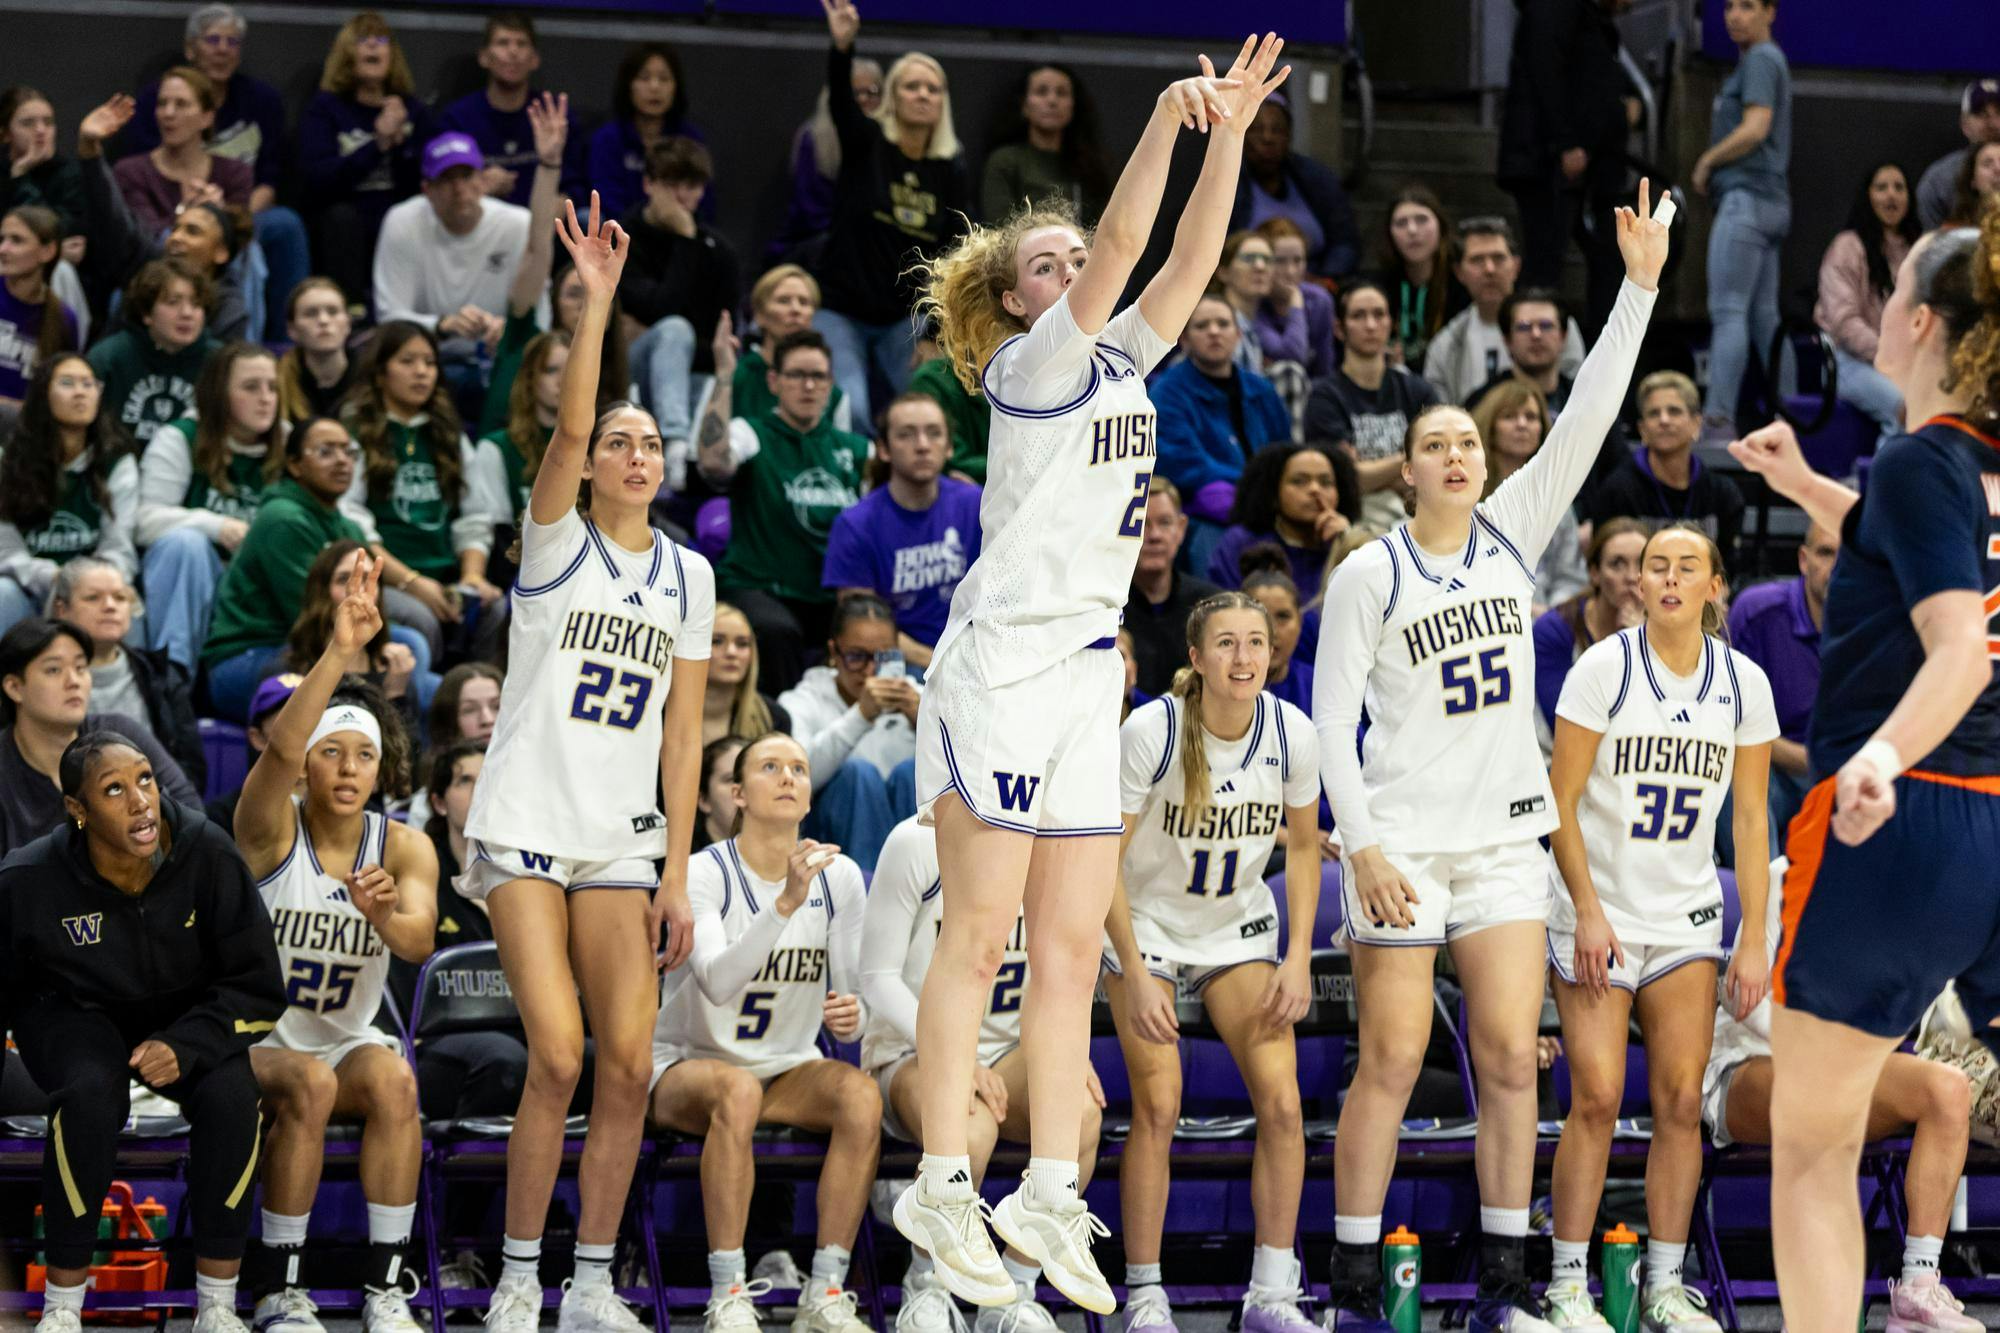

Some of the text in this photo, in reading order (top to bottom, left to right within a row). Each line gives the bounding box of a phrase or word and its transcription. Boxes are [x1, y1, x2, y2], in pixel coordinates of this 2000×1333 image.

[1117, 470, 1151, 540] 2
[559, 611, 674, 675] HUSKIES
[1402, 597, 1523, 668] HUSKIES
[569, 659, 656, 732] 23
[1440, 645, 1512, 718] 55
[1613, 735, 1728, 784] HUSKIES
[992, 770, 1041, 813] W
[1629, 781, 1704, 842] 35
[1185, 848, 1240, 899] 11
[61, 912, 103, 946] W
[286, 957, 364, 1015] 25
[735, 991, 779, 1042] 5
[1394, 1260, 1417, 1289] G
